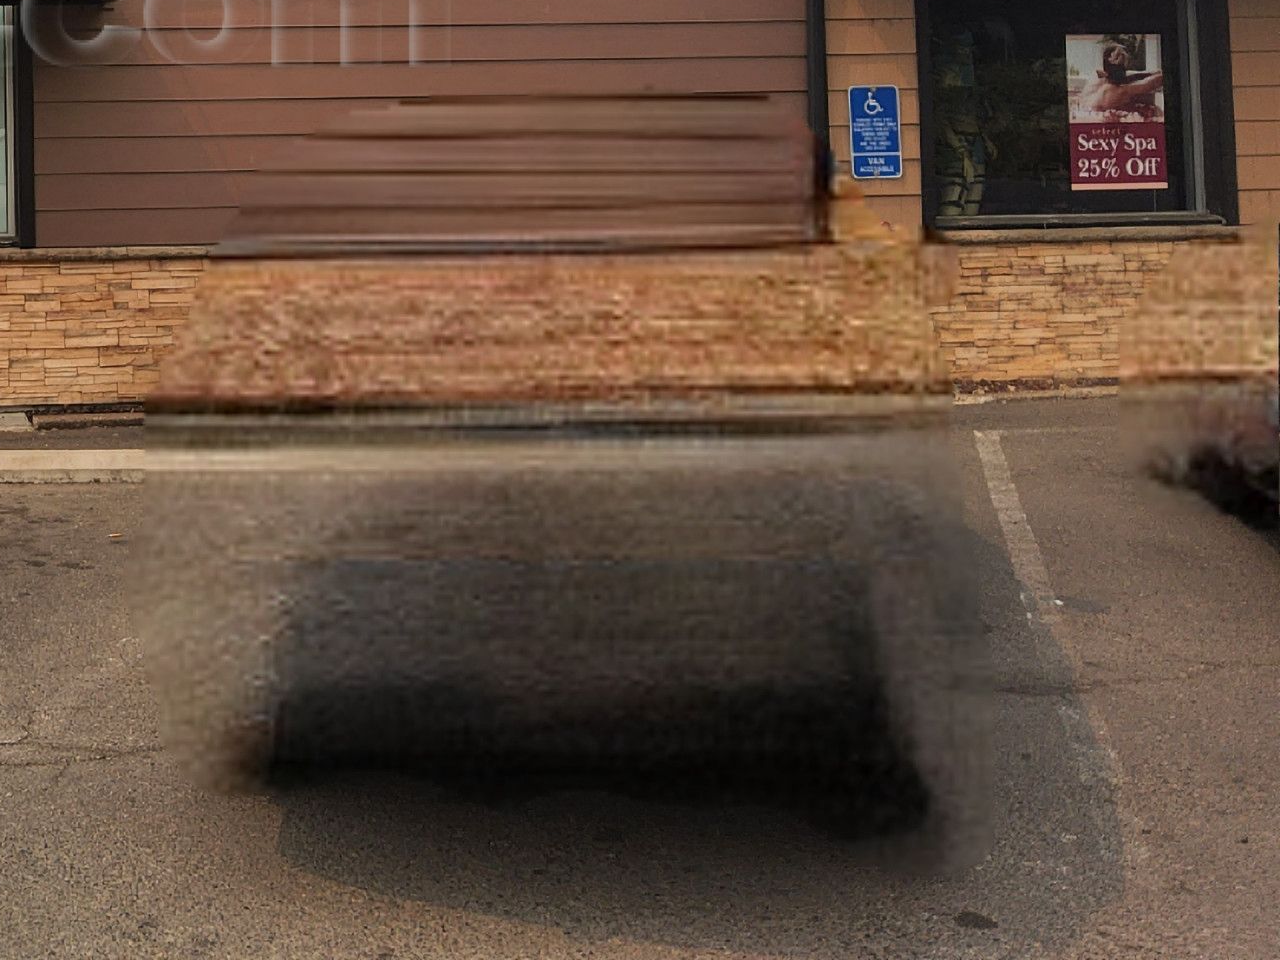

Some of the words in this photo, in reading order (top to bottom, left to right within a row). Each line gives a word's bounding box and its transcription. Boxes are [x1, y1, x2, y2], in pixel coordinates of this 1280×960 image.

[1077, 133, 1119, 157] Sexy
[1124, 133, 1157, 157] Spa
[867, 157, 885, 165] VAN
[1078, 157, 1120, 178] 25%
[1125, 157, 1161, 177] Off
